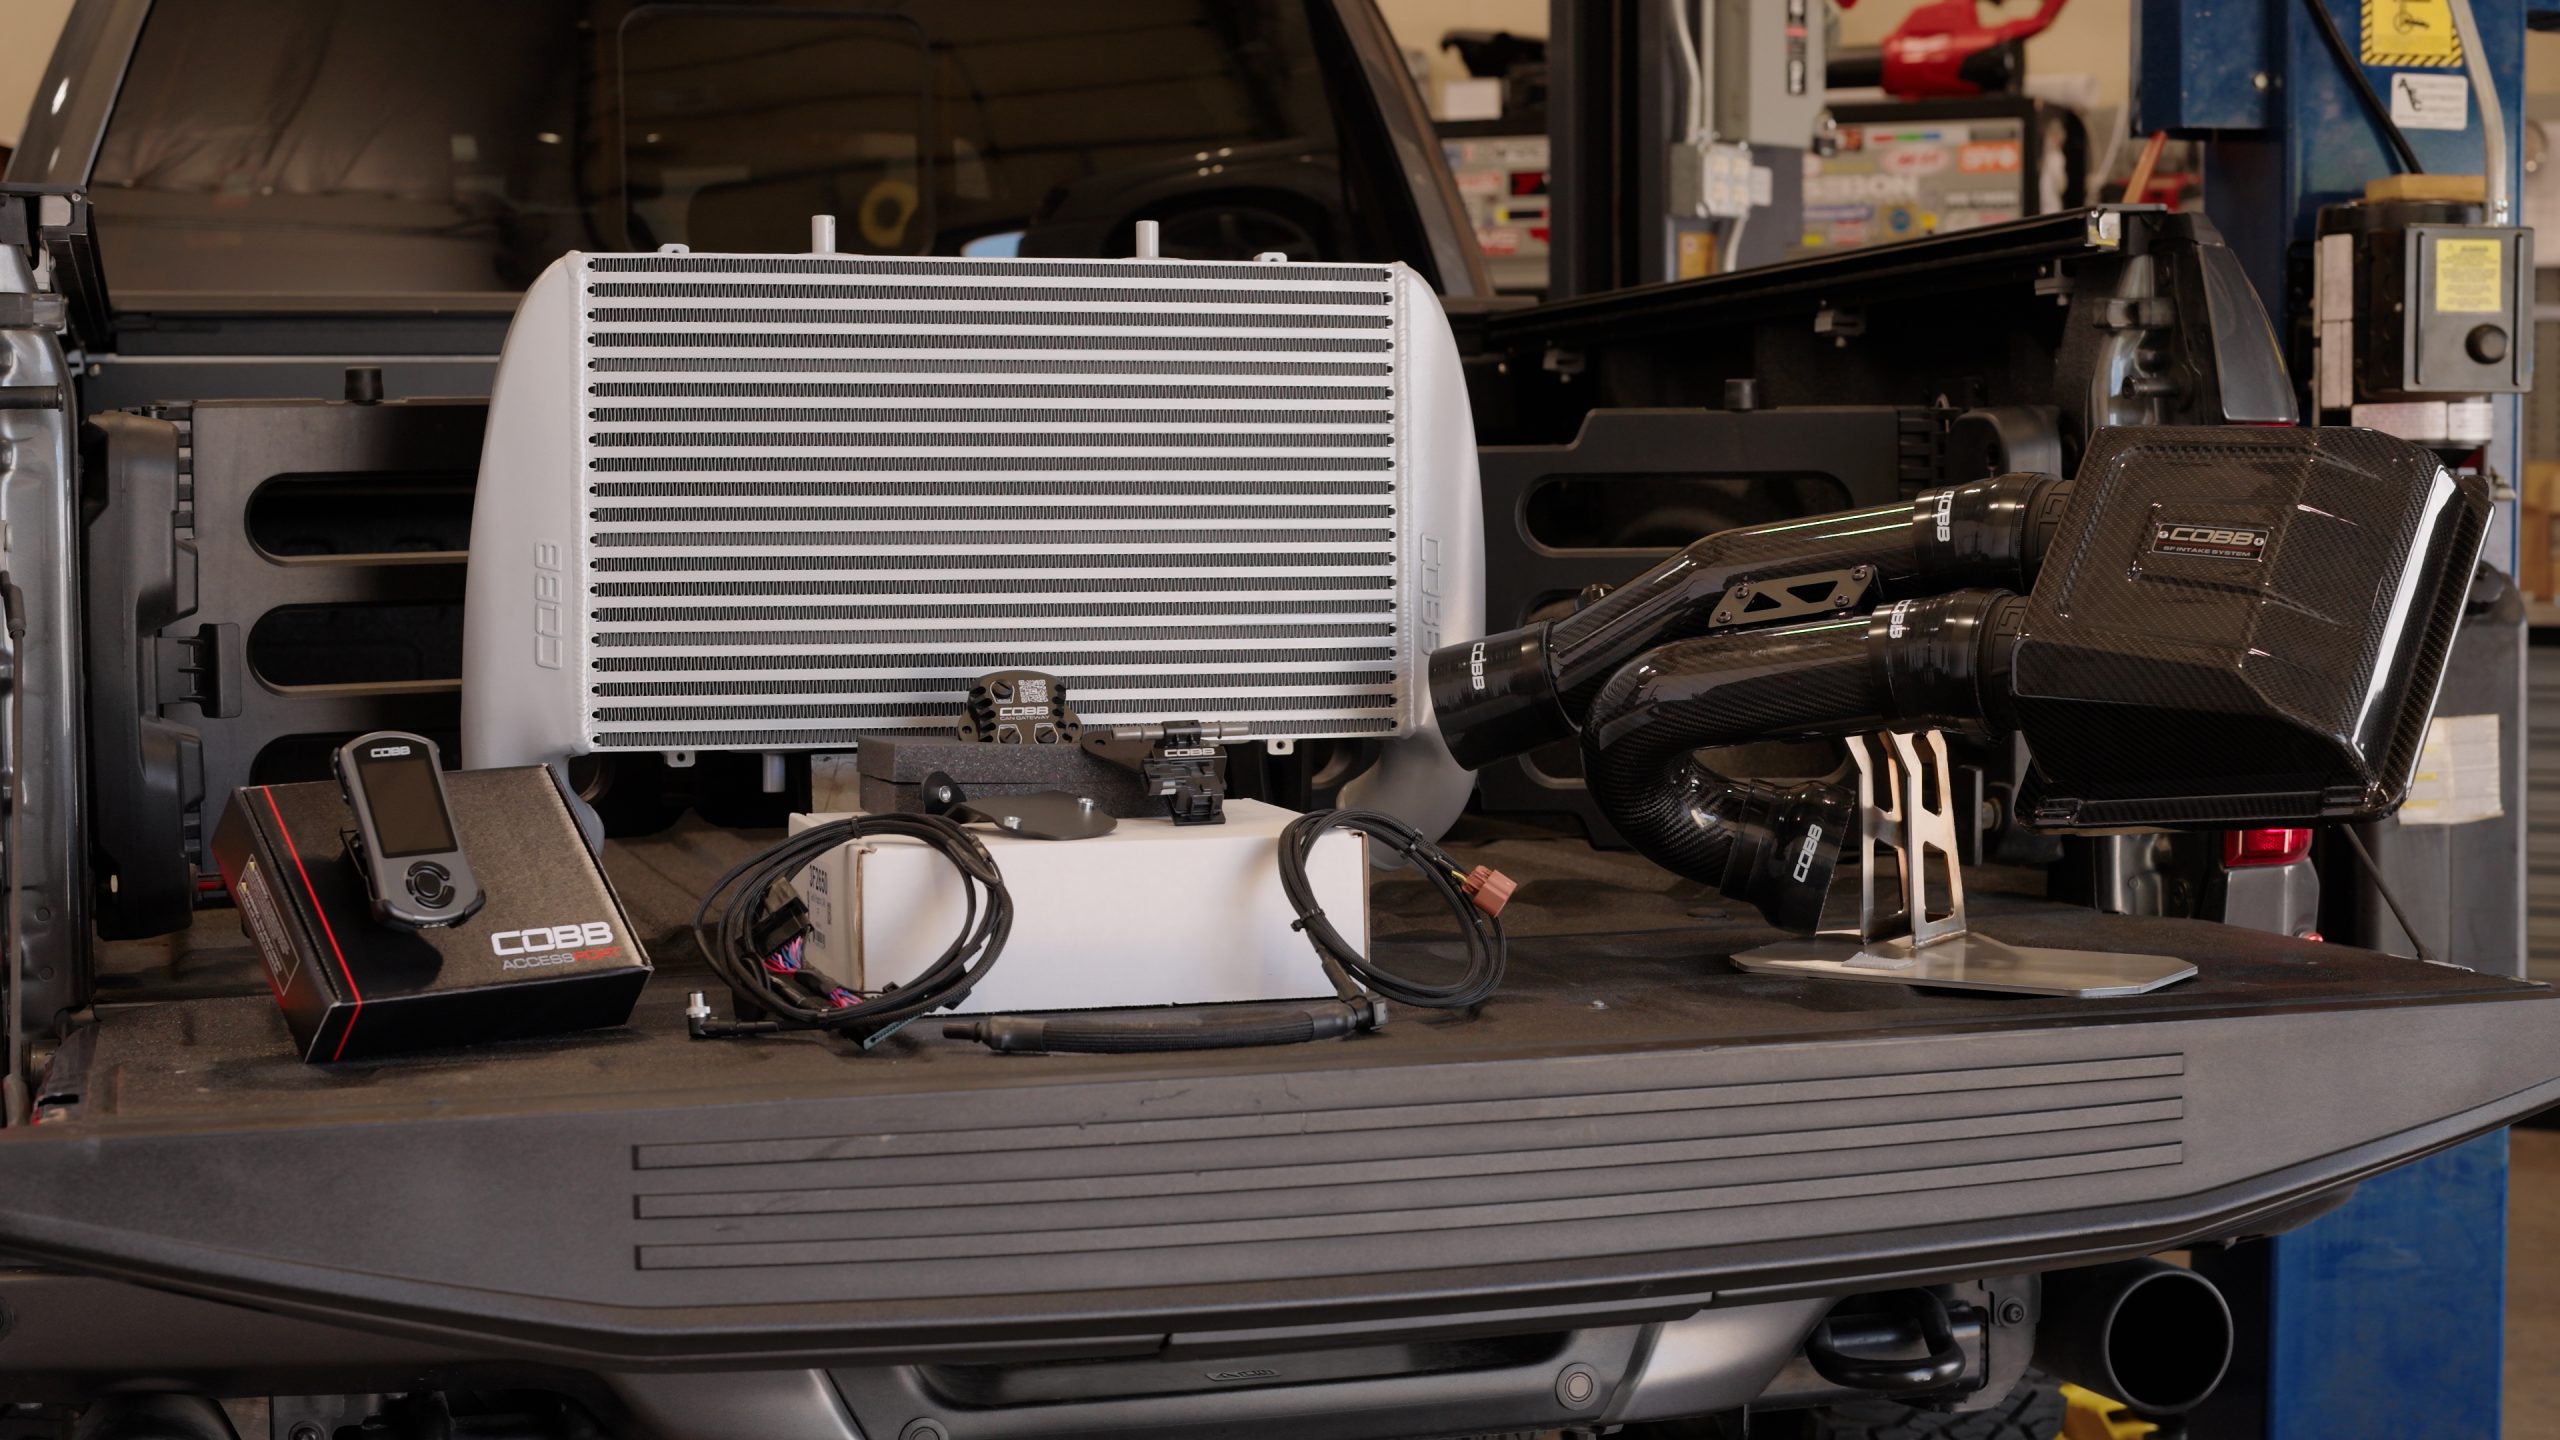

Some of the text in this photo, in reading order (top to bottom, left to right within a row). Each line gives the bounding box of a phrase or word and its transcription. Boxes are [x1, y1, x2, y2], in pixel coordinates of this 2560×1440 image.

[1937, 490, 1955, 542] COBB
[2169, 527, 2255, 546] COBB
[2176, 546, 2211, 554] INTAKE
[2211, 549, 2252, 557] SYSTEM
[534, 539, 562, 671] COBB
[1420, 533, 1441, 656] COBB
[1470, 642, 1487, 691] COBB
[1000, 706, 1049, 717] COBB
[370, 745, 411, 758] COBB
[1164, 747, 1216, 757] COBB
[1792, 823, 1823, 883] COBB
[490, 921, 614, 956] COBB
[502, 945, 622, 970] ACCESSPORT
